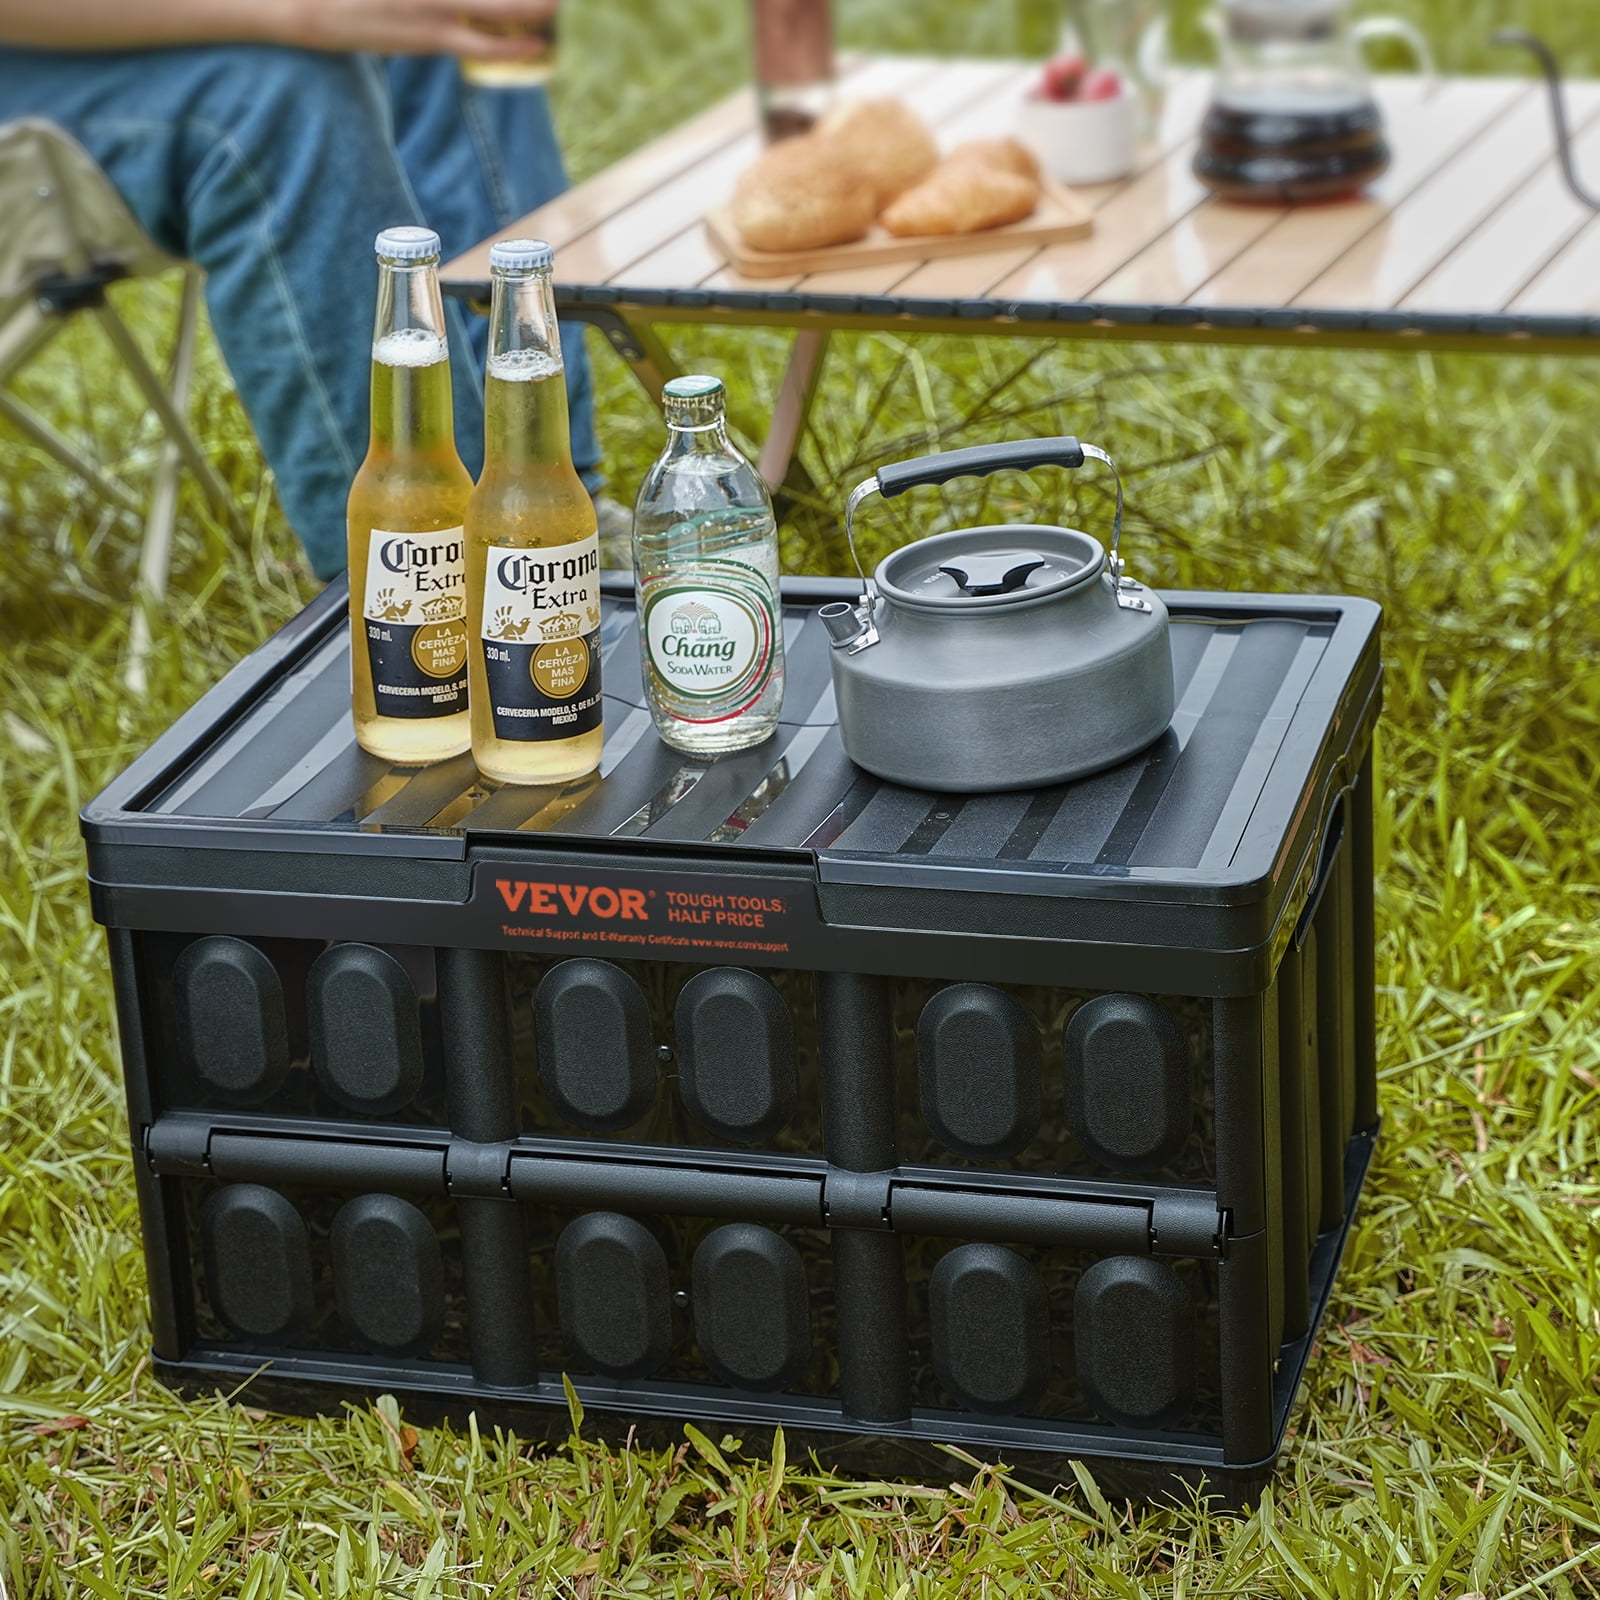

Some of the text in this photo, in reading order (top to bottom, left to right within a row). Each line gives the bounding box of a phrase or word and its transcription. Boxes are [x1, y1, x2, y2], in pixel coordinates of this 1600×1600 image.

[380, 538, 464, 578] Coro
[497, 549, 597, 595] Corona
[532, 587, 587, 610] Extra
[368, 626, 380, 640] 330
[436, 628, 452, 638] LA
[418, 633, 466, 650] CERVEZA
[662, 635, 736, 661] Chang
[432, 646, 456, 659] MAS
[486, 646, 499, 661] 330
[555, 647, 570, 657] LA
[432, 656, 457, 669] FINA
[537, 653, 585, 670] CERVEZA
[551, 665, 575, 678] MAS
[551, 676, 576, 688] FINA
[377, 683, 421, 697] CERVECERIA
[432, 691, 458, 704] MEXICO
[496, 706, 540, 718] CERVECERIA
[552, 713, 578, 725] MEXICO
[496, 879, 649, 920] VEVOR
[666, 891, 787, 913] TOUGH TOOLS,
[668, 908, 765, 928] HALF PRICE
[502, 925, 544, 938] Technical
[582, 931, 598, 940] and
